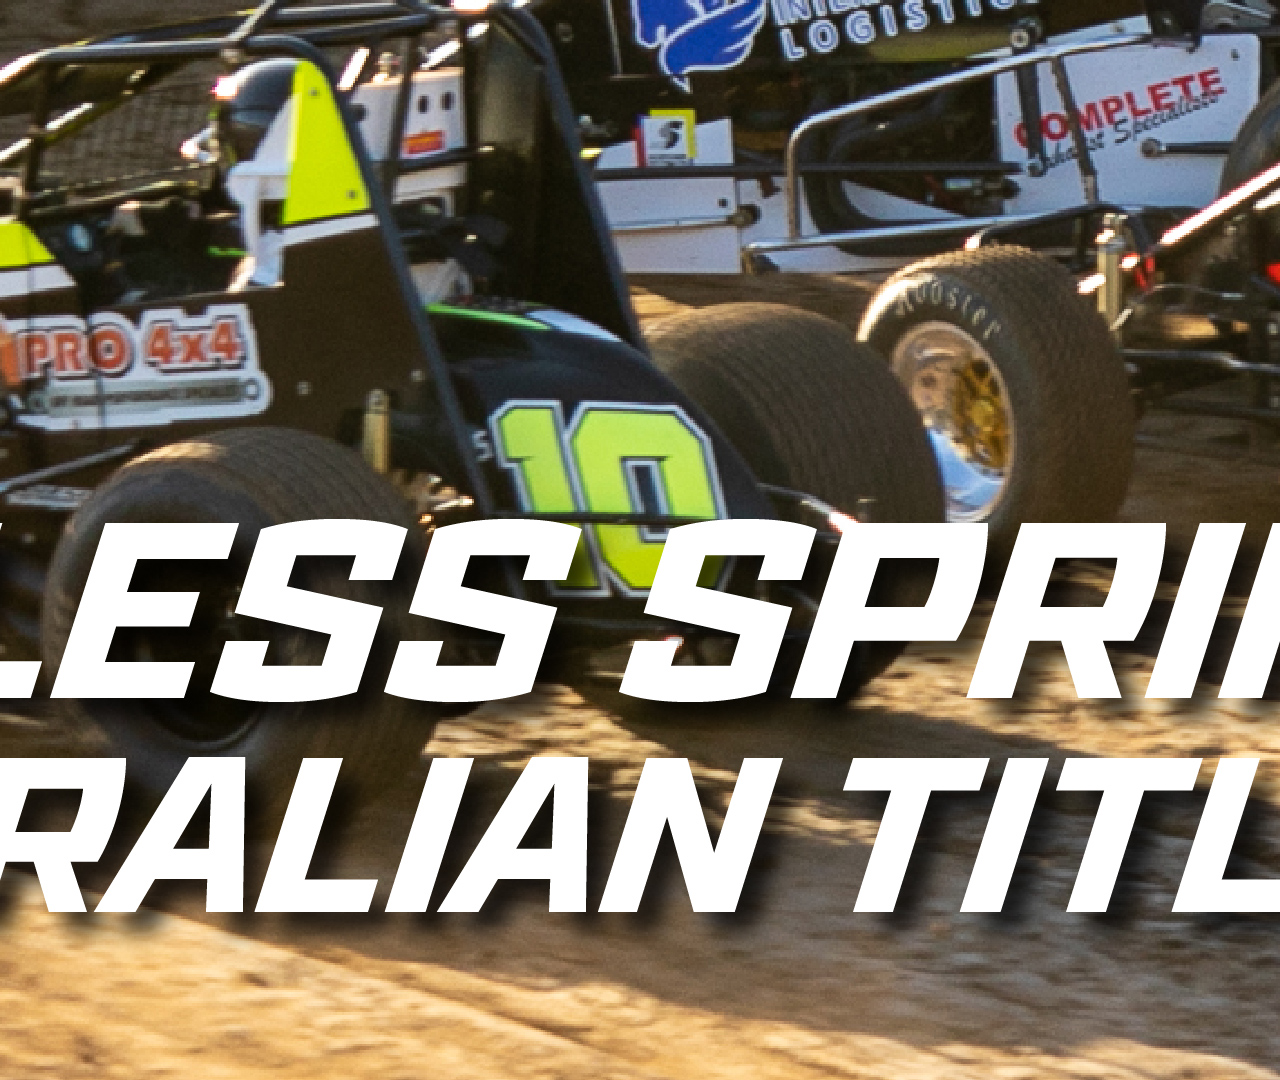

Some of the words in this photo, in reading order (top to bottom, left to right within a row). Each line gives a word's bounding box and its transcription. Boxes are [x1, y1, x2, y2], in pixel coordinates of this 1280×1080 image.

[22, 322, 135, 379] PRO
[144, 313, 250, 376] 4x4
[471, 429, 494, 462] S
[487, 399, 732, 601] 10
